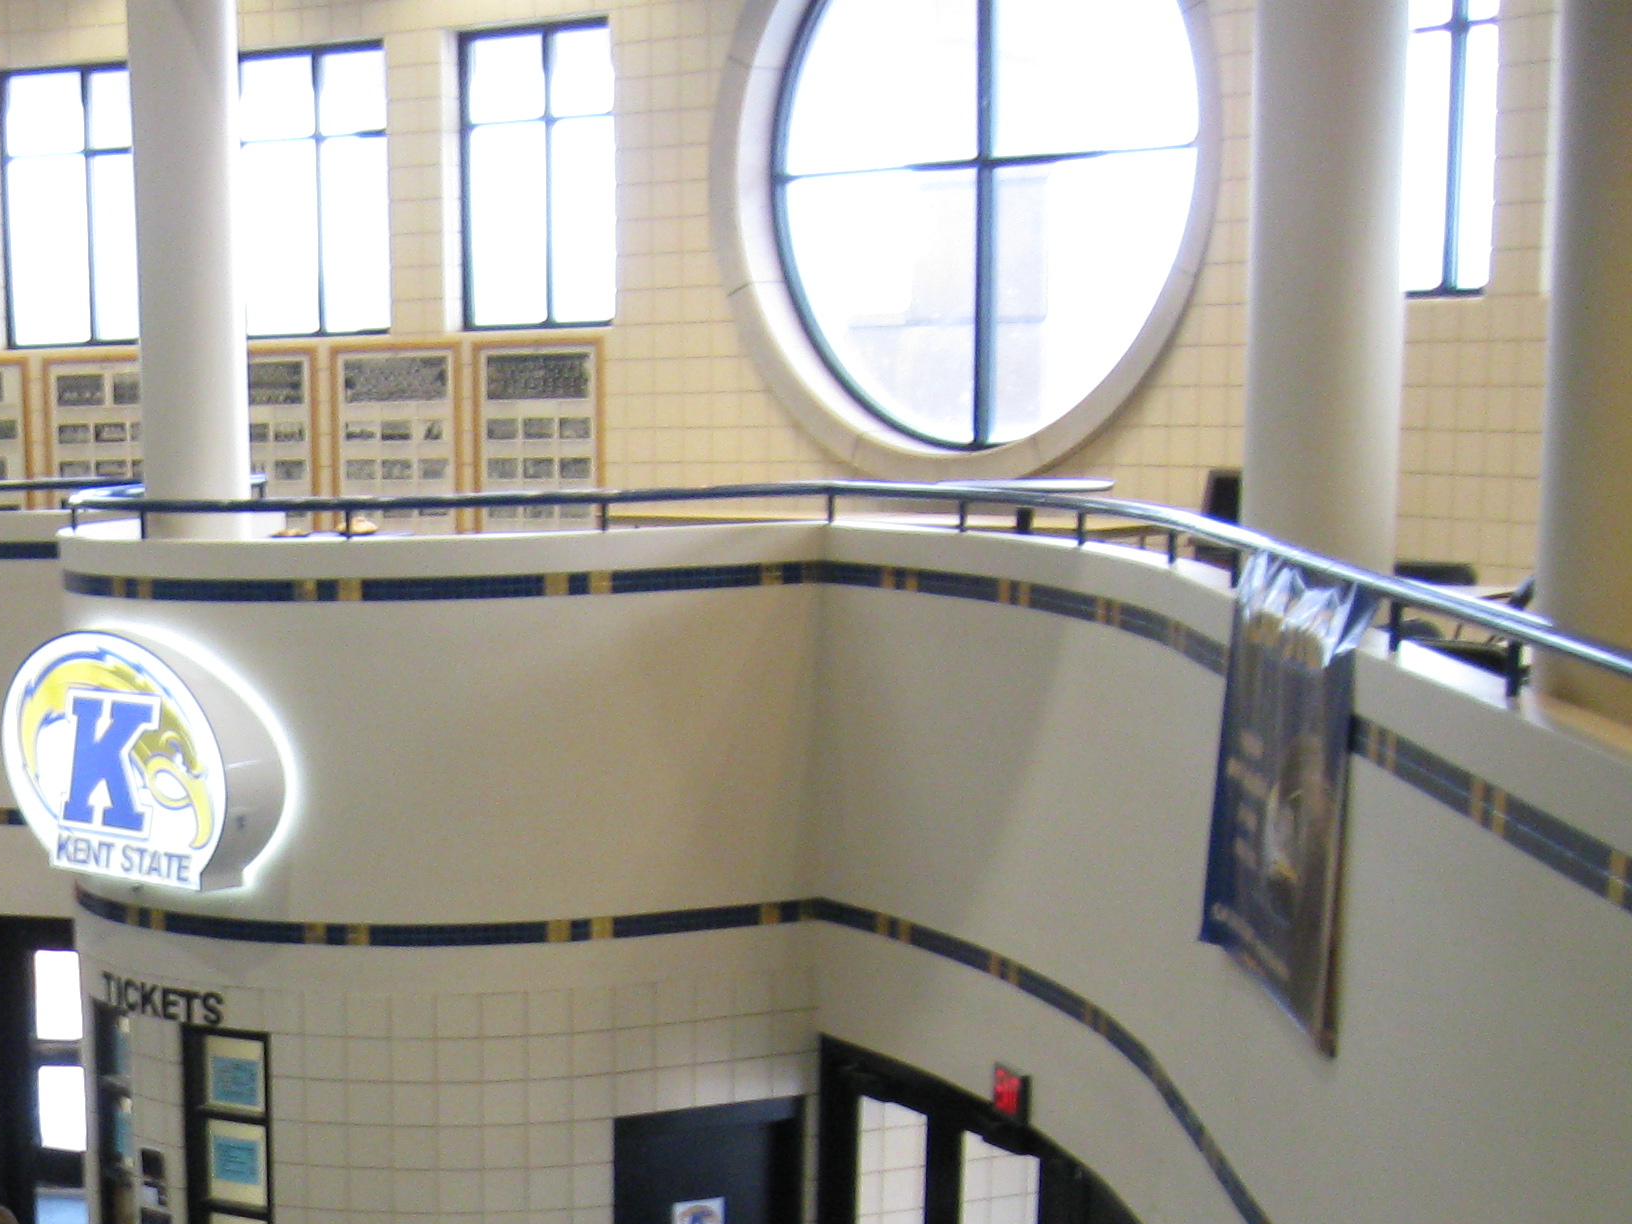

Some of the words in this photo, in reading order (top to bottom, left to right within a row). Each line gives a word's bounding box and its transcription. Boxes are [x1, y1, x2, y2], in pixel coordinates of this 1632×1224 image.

[61, 694, 156, 833] K
[56, 831, 115, 869] KENT
[120, 843, 192, 882] STATE
[102, 969, 224, 1025] TICKETS
